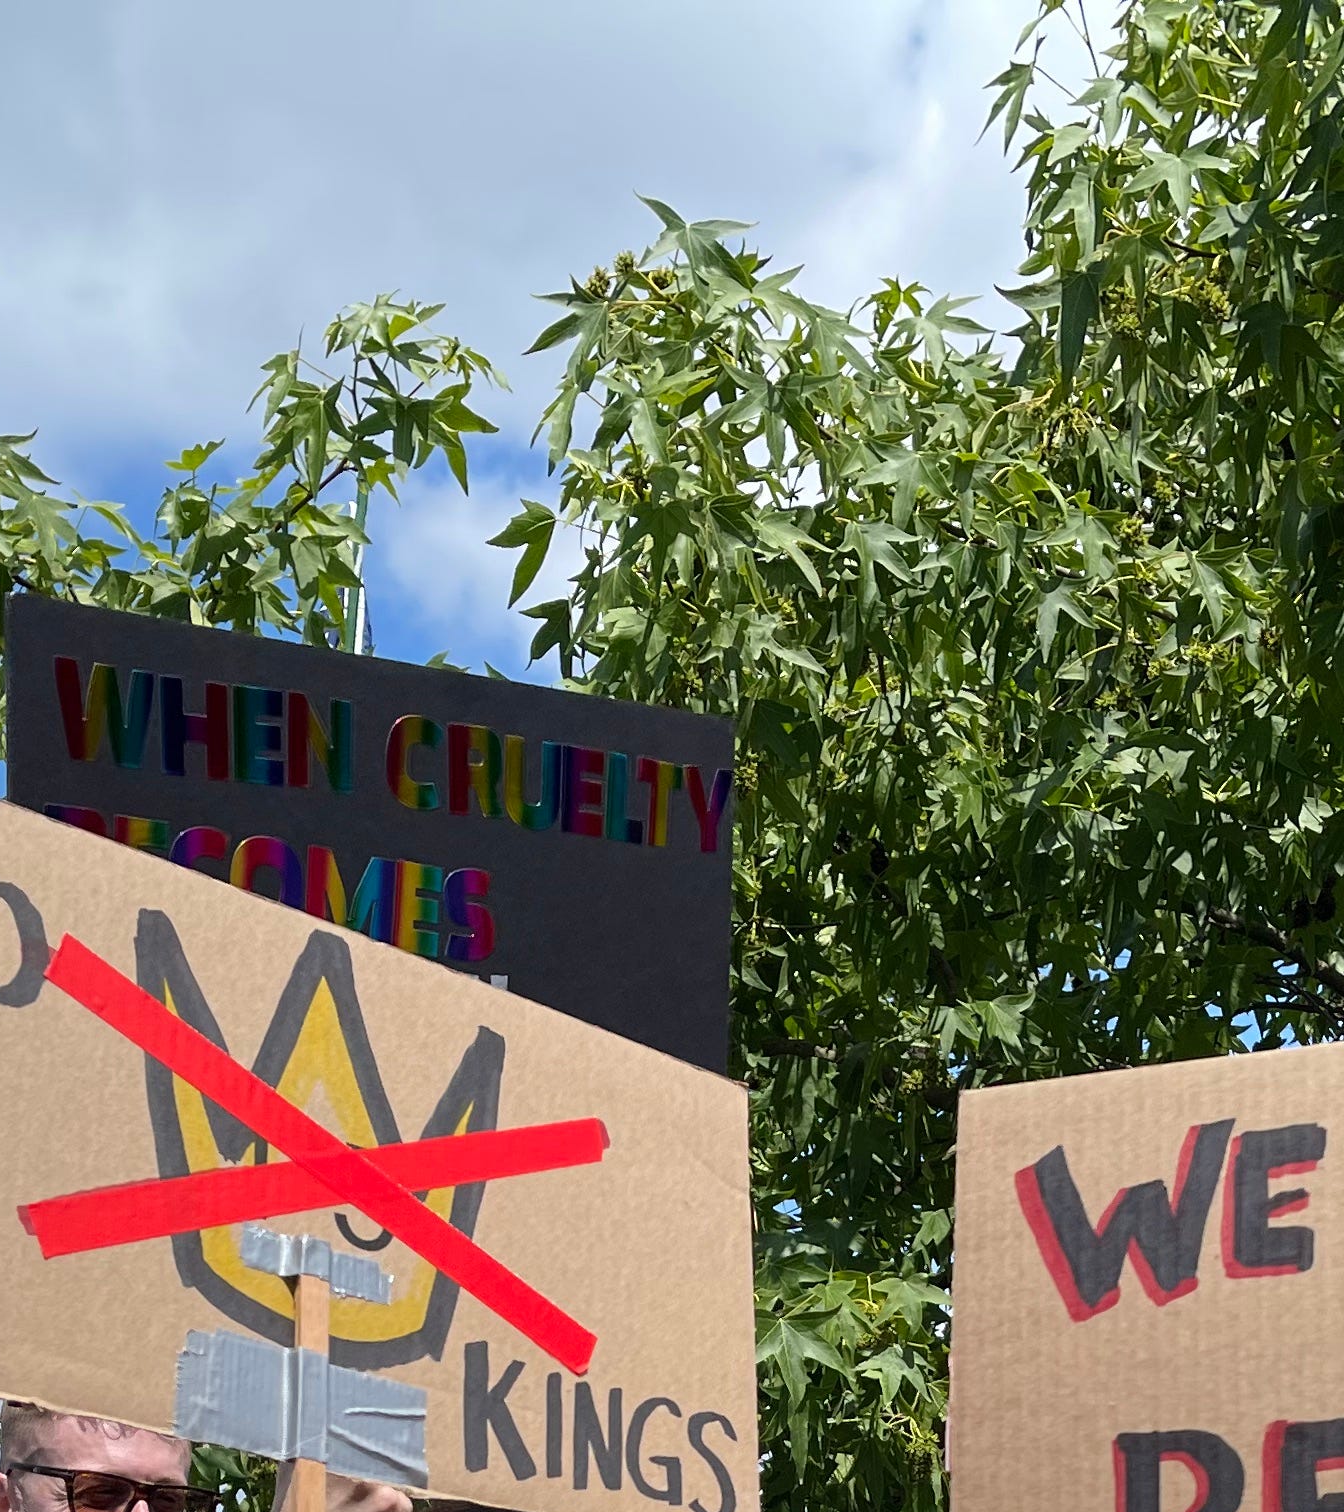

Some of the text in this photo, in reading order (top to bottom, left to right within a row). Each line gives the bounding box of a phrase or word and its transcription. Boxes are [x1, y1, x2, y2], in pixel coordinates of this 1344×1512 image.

[54, 655, 734, 855] WHEN CRUELTY
[1015, 1118, 1328, 1324] WE
